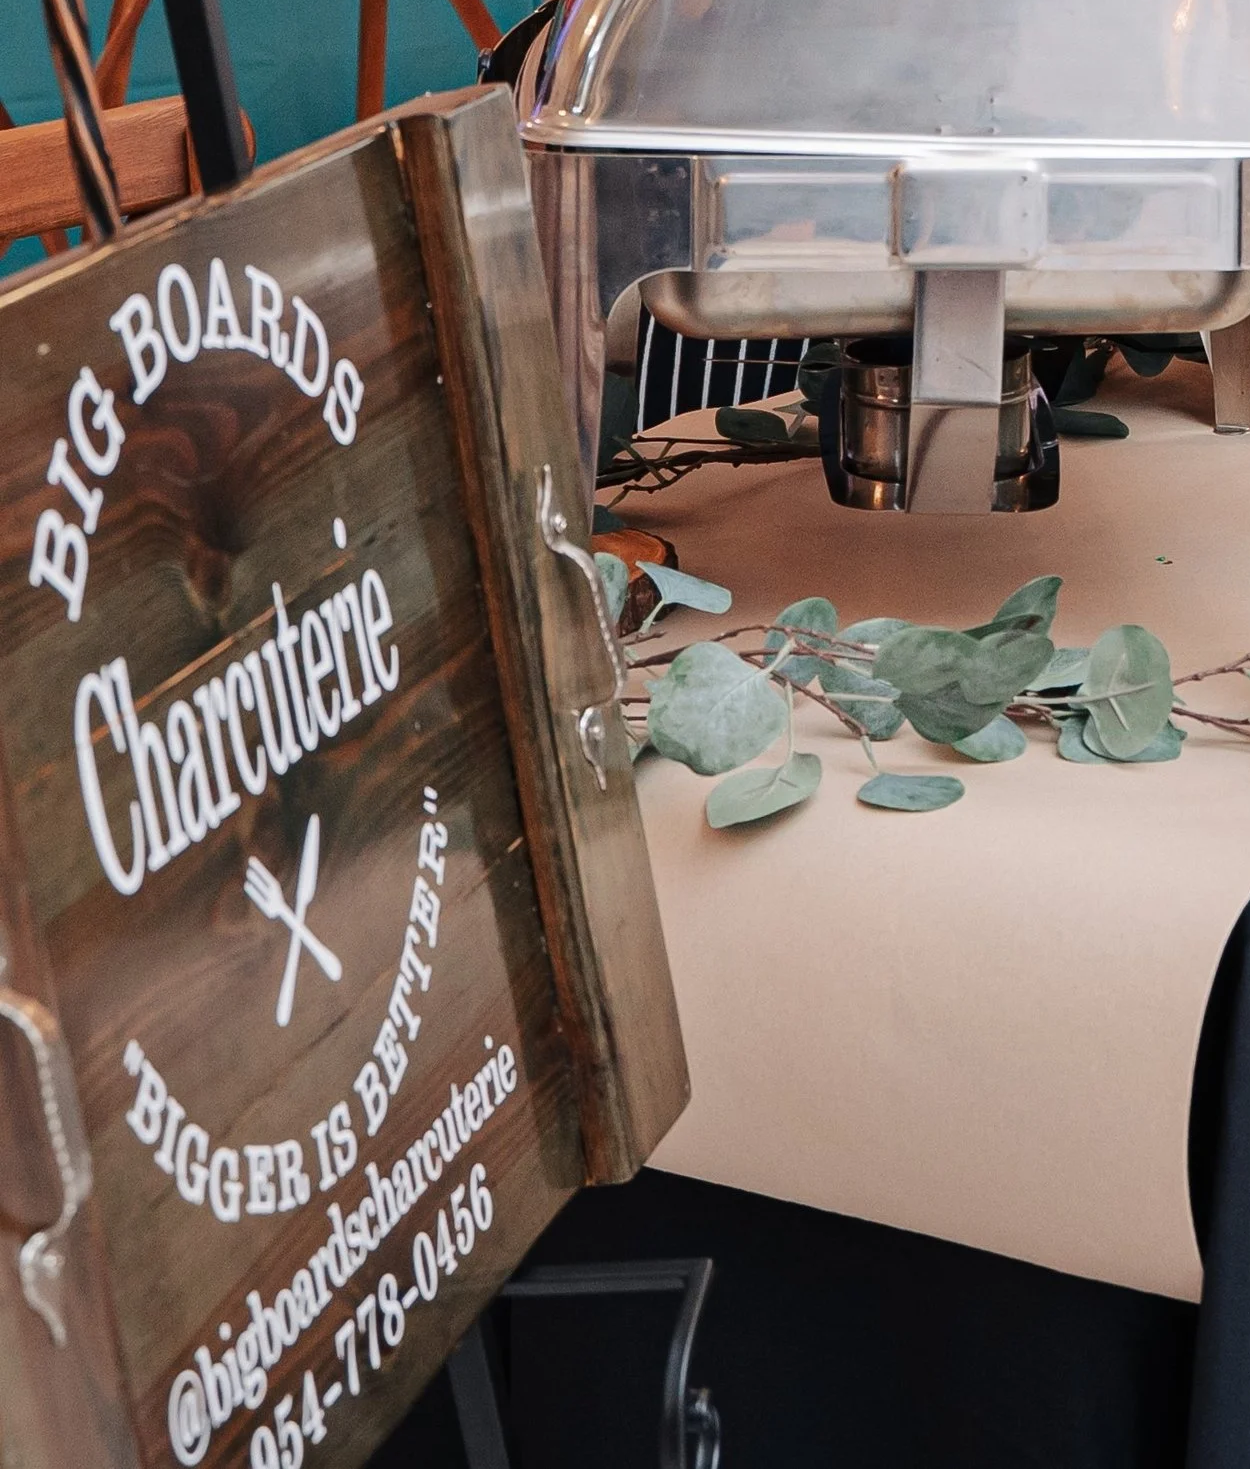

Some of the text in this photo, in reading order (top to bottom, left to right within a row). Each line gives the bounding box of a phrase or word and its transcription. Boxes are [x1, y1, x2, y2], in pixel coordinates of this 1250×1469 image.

[29, 257, 366, 622] BIG BOARDS
[74, 516, 401, 897] Charcuterie
[311, 1100, 358, 1193] IS
[352, 785, 449, 1137] BETTER"
[167, 1035, 518, 1467] @bigboardscharcuterie
[250, 1162, 494, 1469] 954-778-0456
